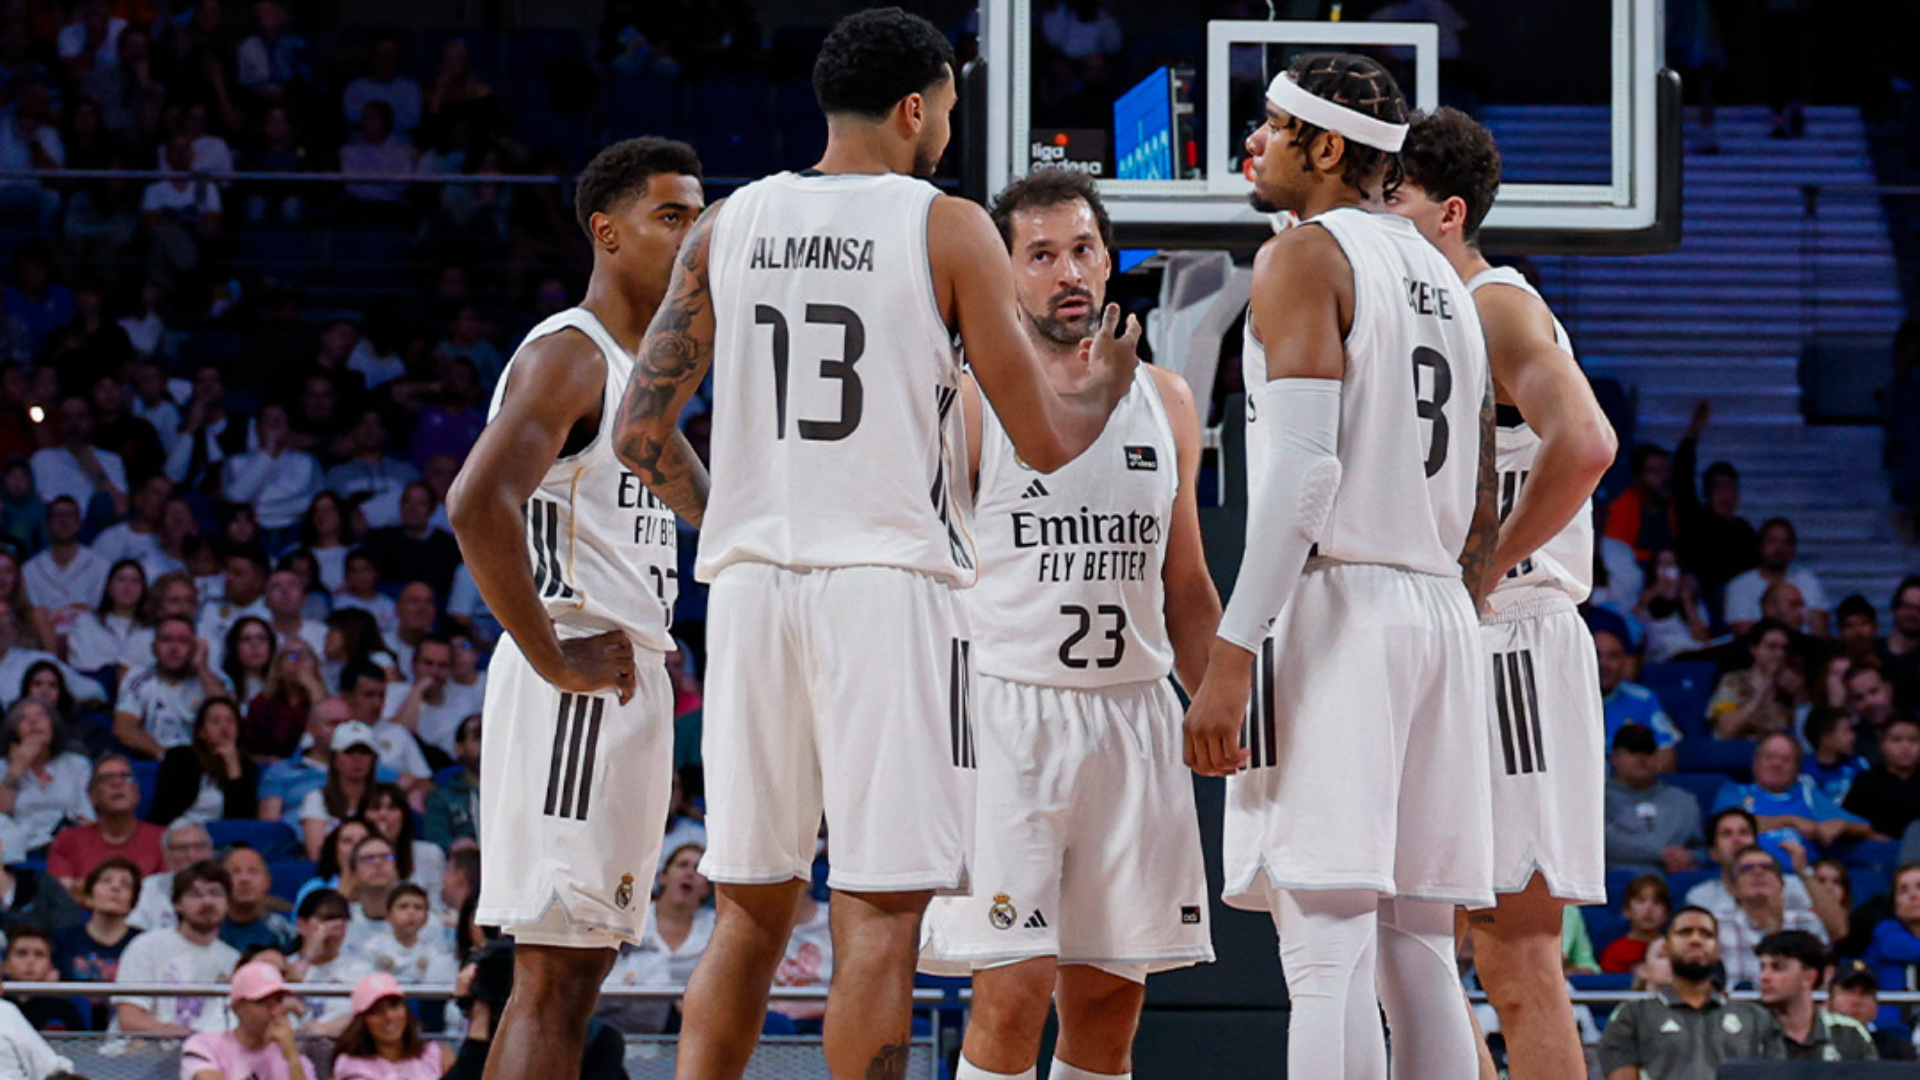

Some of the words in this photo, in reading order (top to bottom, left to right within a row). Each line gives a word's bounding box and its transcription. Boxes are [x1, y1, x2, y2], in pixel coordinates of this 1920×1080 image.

[1032, 142, 1064, 161] liga
[750, 236, 875, 272] ALMANSA
[755, 303, 866, 442] 13
[1011, 506, 1161, 548] Emirates
[1038, 551, 1076, 582] FLY
[1083, 551, 1147, 581] BETTER
[1058, 605, 1127, 669] 23
